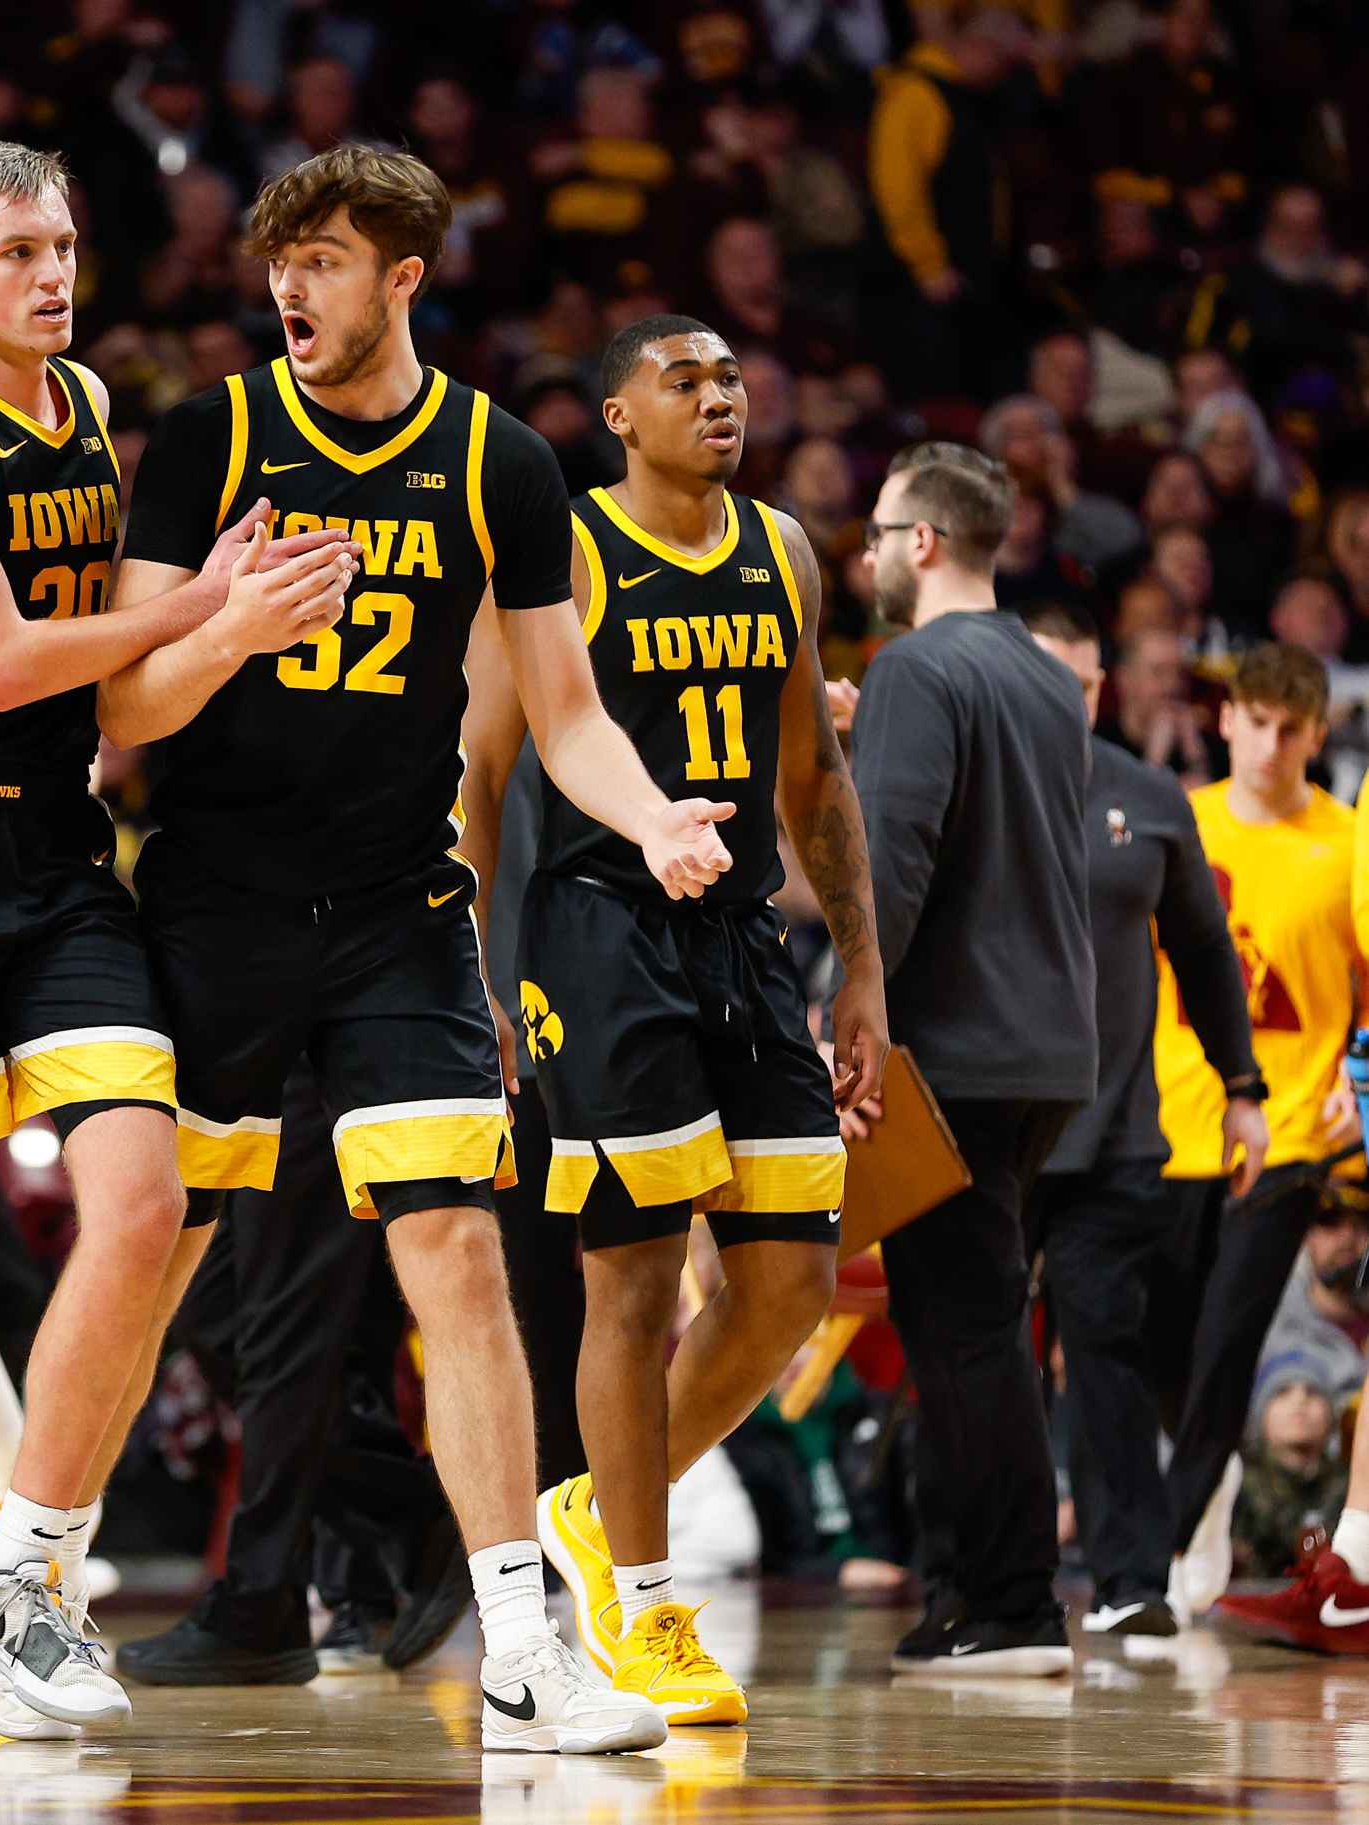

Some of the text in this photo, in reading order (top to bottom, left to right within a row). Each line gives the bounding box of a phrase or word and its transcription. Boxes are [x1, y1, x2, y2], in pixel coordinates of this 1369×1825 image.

[8, 484, 120, 551] IOWA
[626, 614, 786, 672] IOWA
[678, 685, 750, 780] 11
